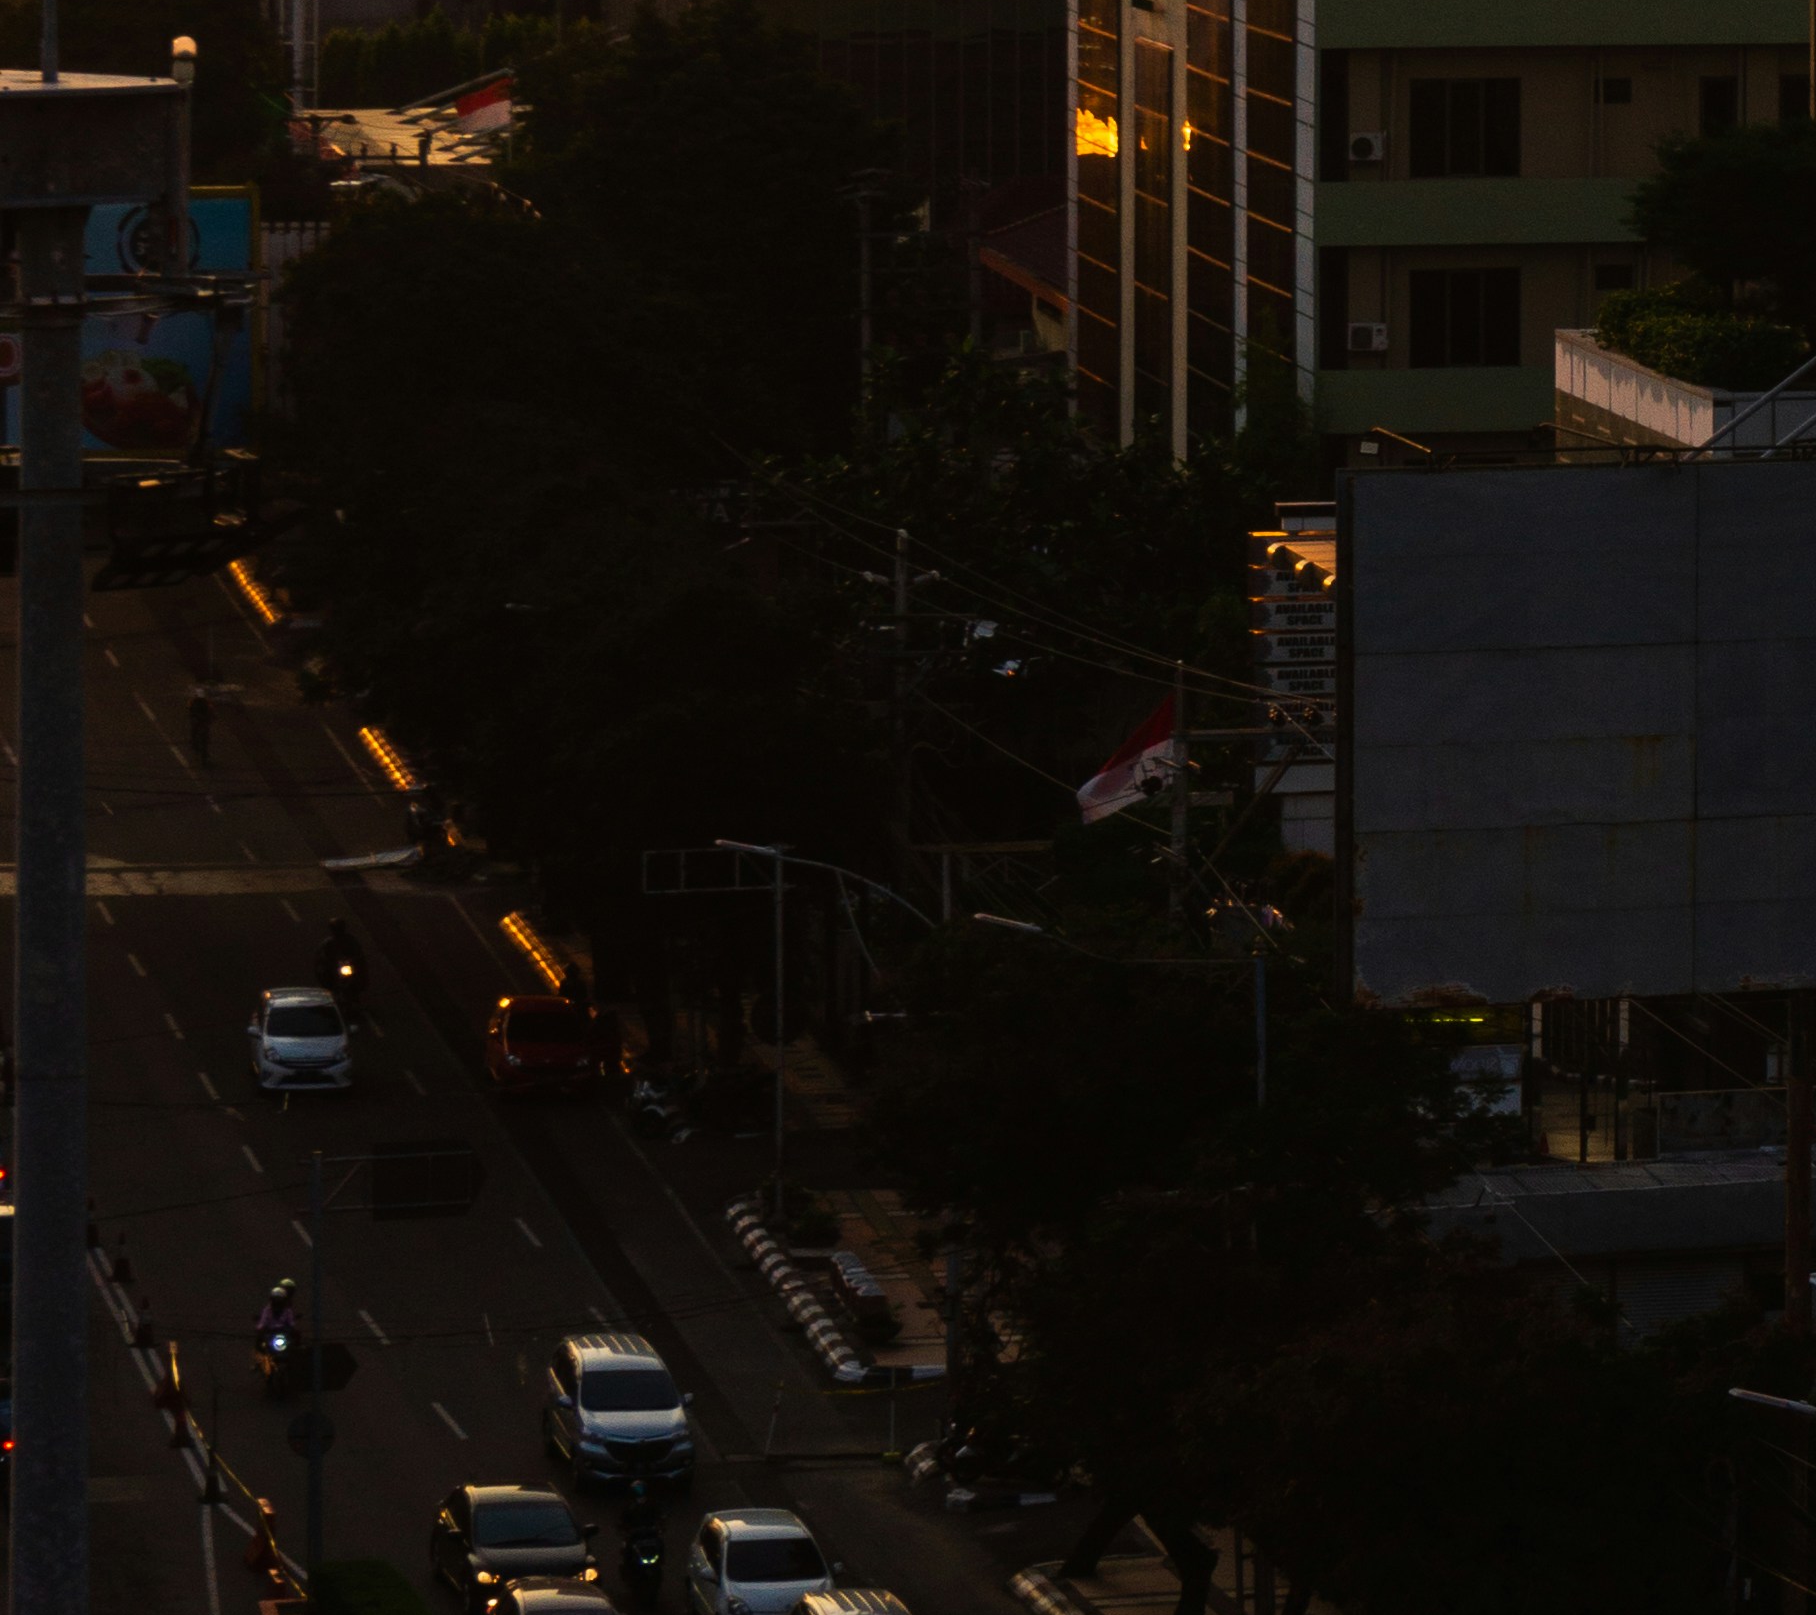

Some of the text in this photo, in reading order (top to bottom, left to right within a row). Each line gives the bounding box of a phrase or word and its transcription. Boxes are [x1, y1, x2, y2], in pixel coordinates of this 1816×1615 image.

[1275, 604, 1334, 615] AVAILABLE
[1286, 615, 1323, 626] SPACE
[1288, 647, 1325, 658] SPACE
[1288, 680, 1325, 691] SPACE
